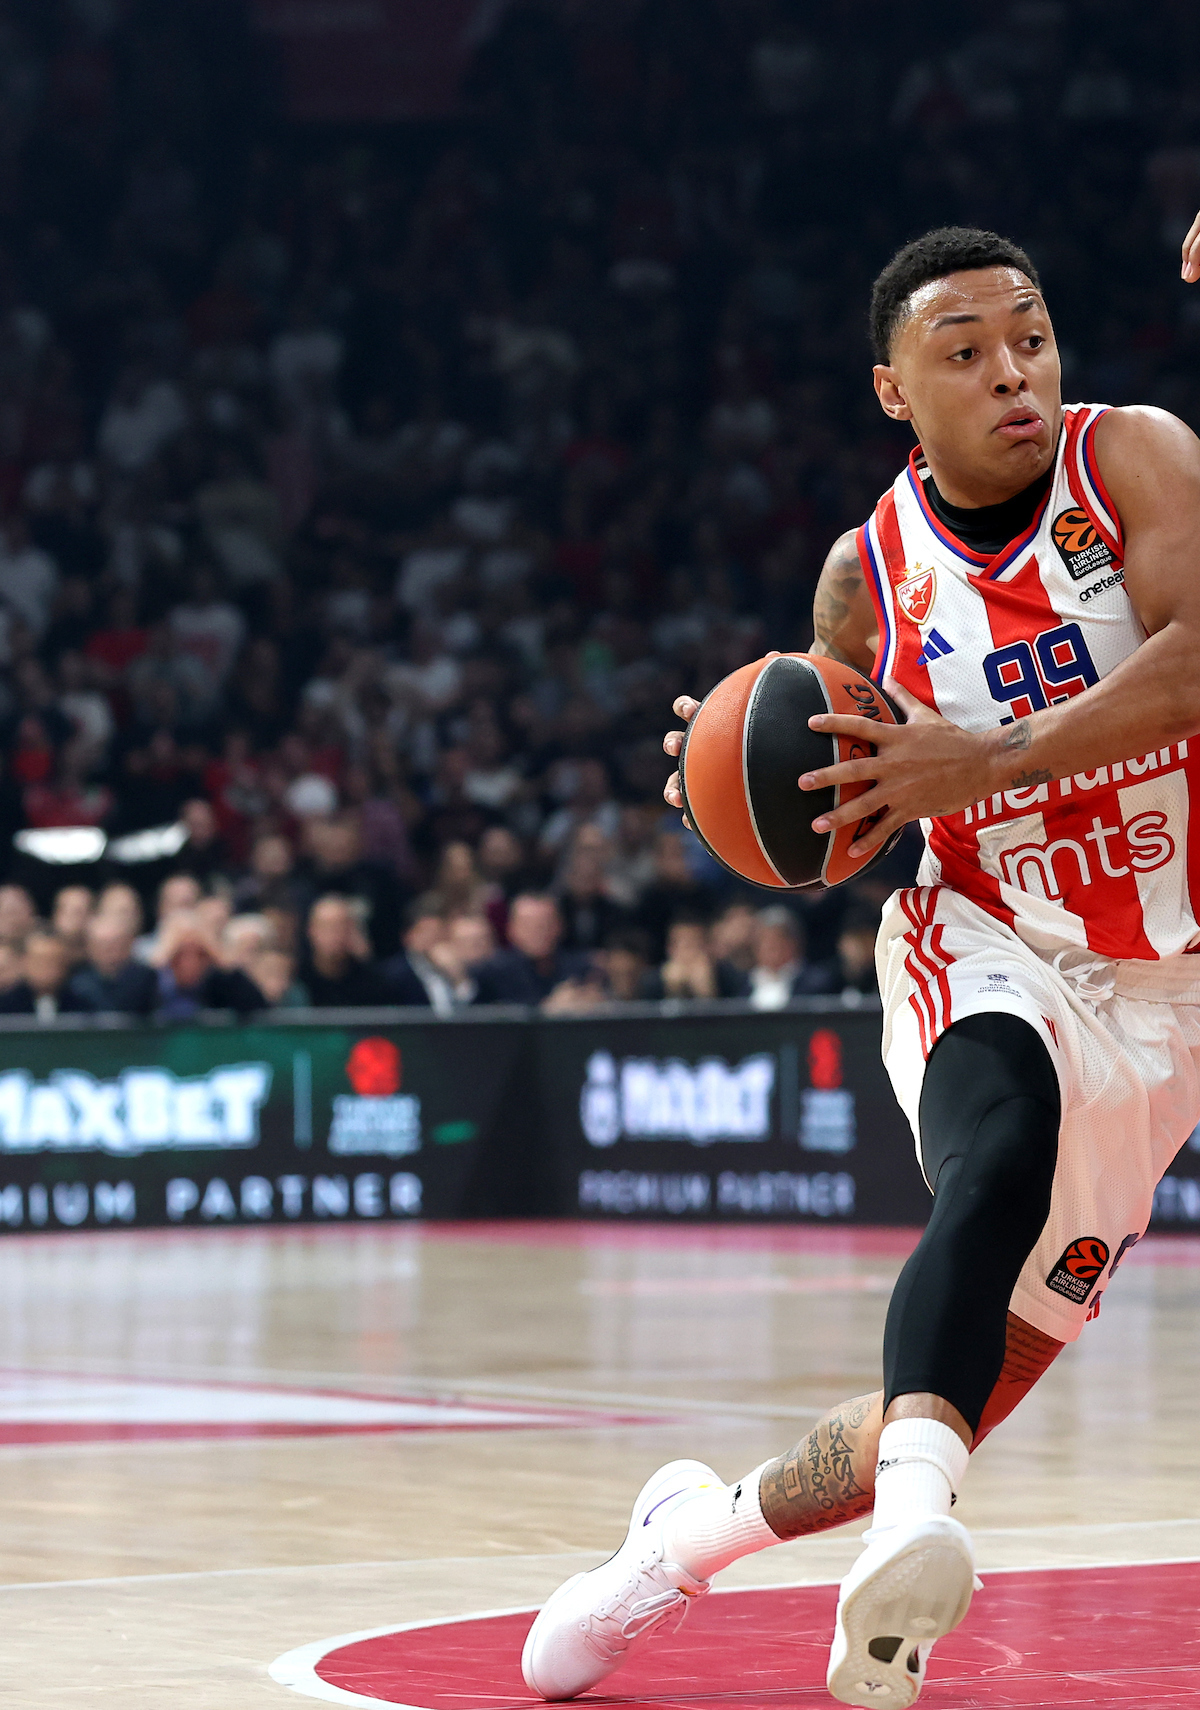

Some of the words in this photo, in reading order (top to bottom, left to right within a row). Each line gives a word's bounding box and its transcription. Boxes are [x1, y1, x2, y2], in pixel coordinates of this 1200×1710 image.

[1068, 541, 1107, 565] TURKISH
[1072, 548, 1110, 572] AIRLINES
[1074, 555, 1113, 577] EuroLeague
[983, 622, 1100, 726] 99
[1002, 811, 1174, 897] mts
[165, 1172, 423, 1222] PARTNER
[1052, 1276, 1087, 1296] AIRLINES
[1057, 1269, 1090, 1290] TURKISH
